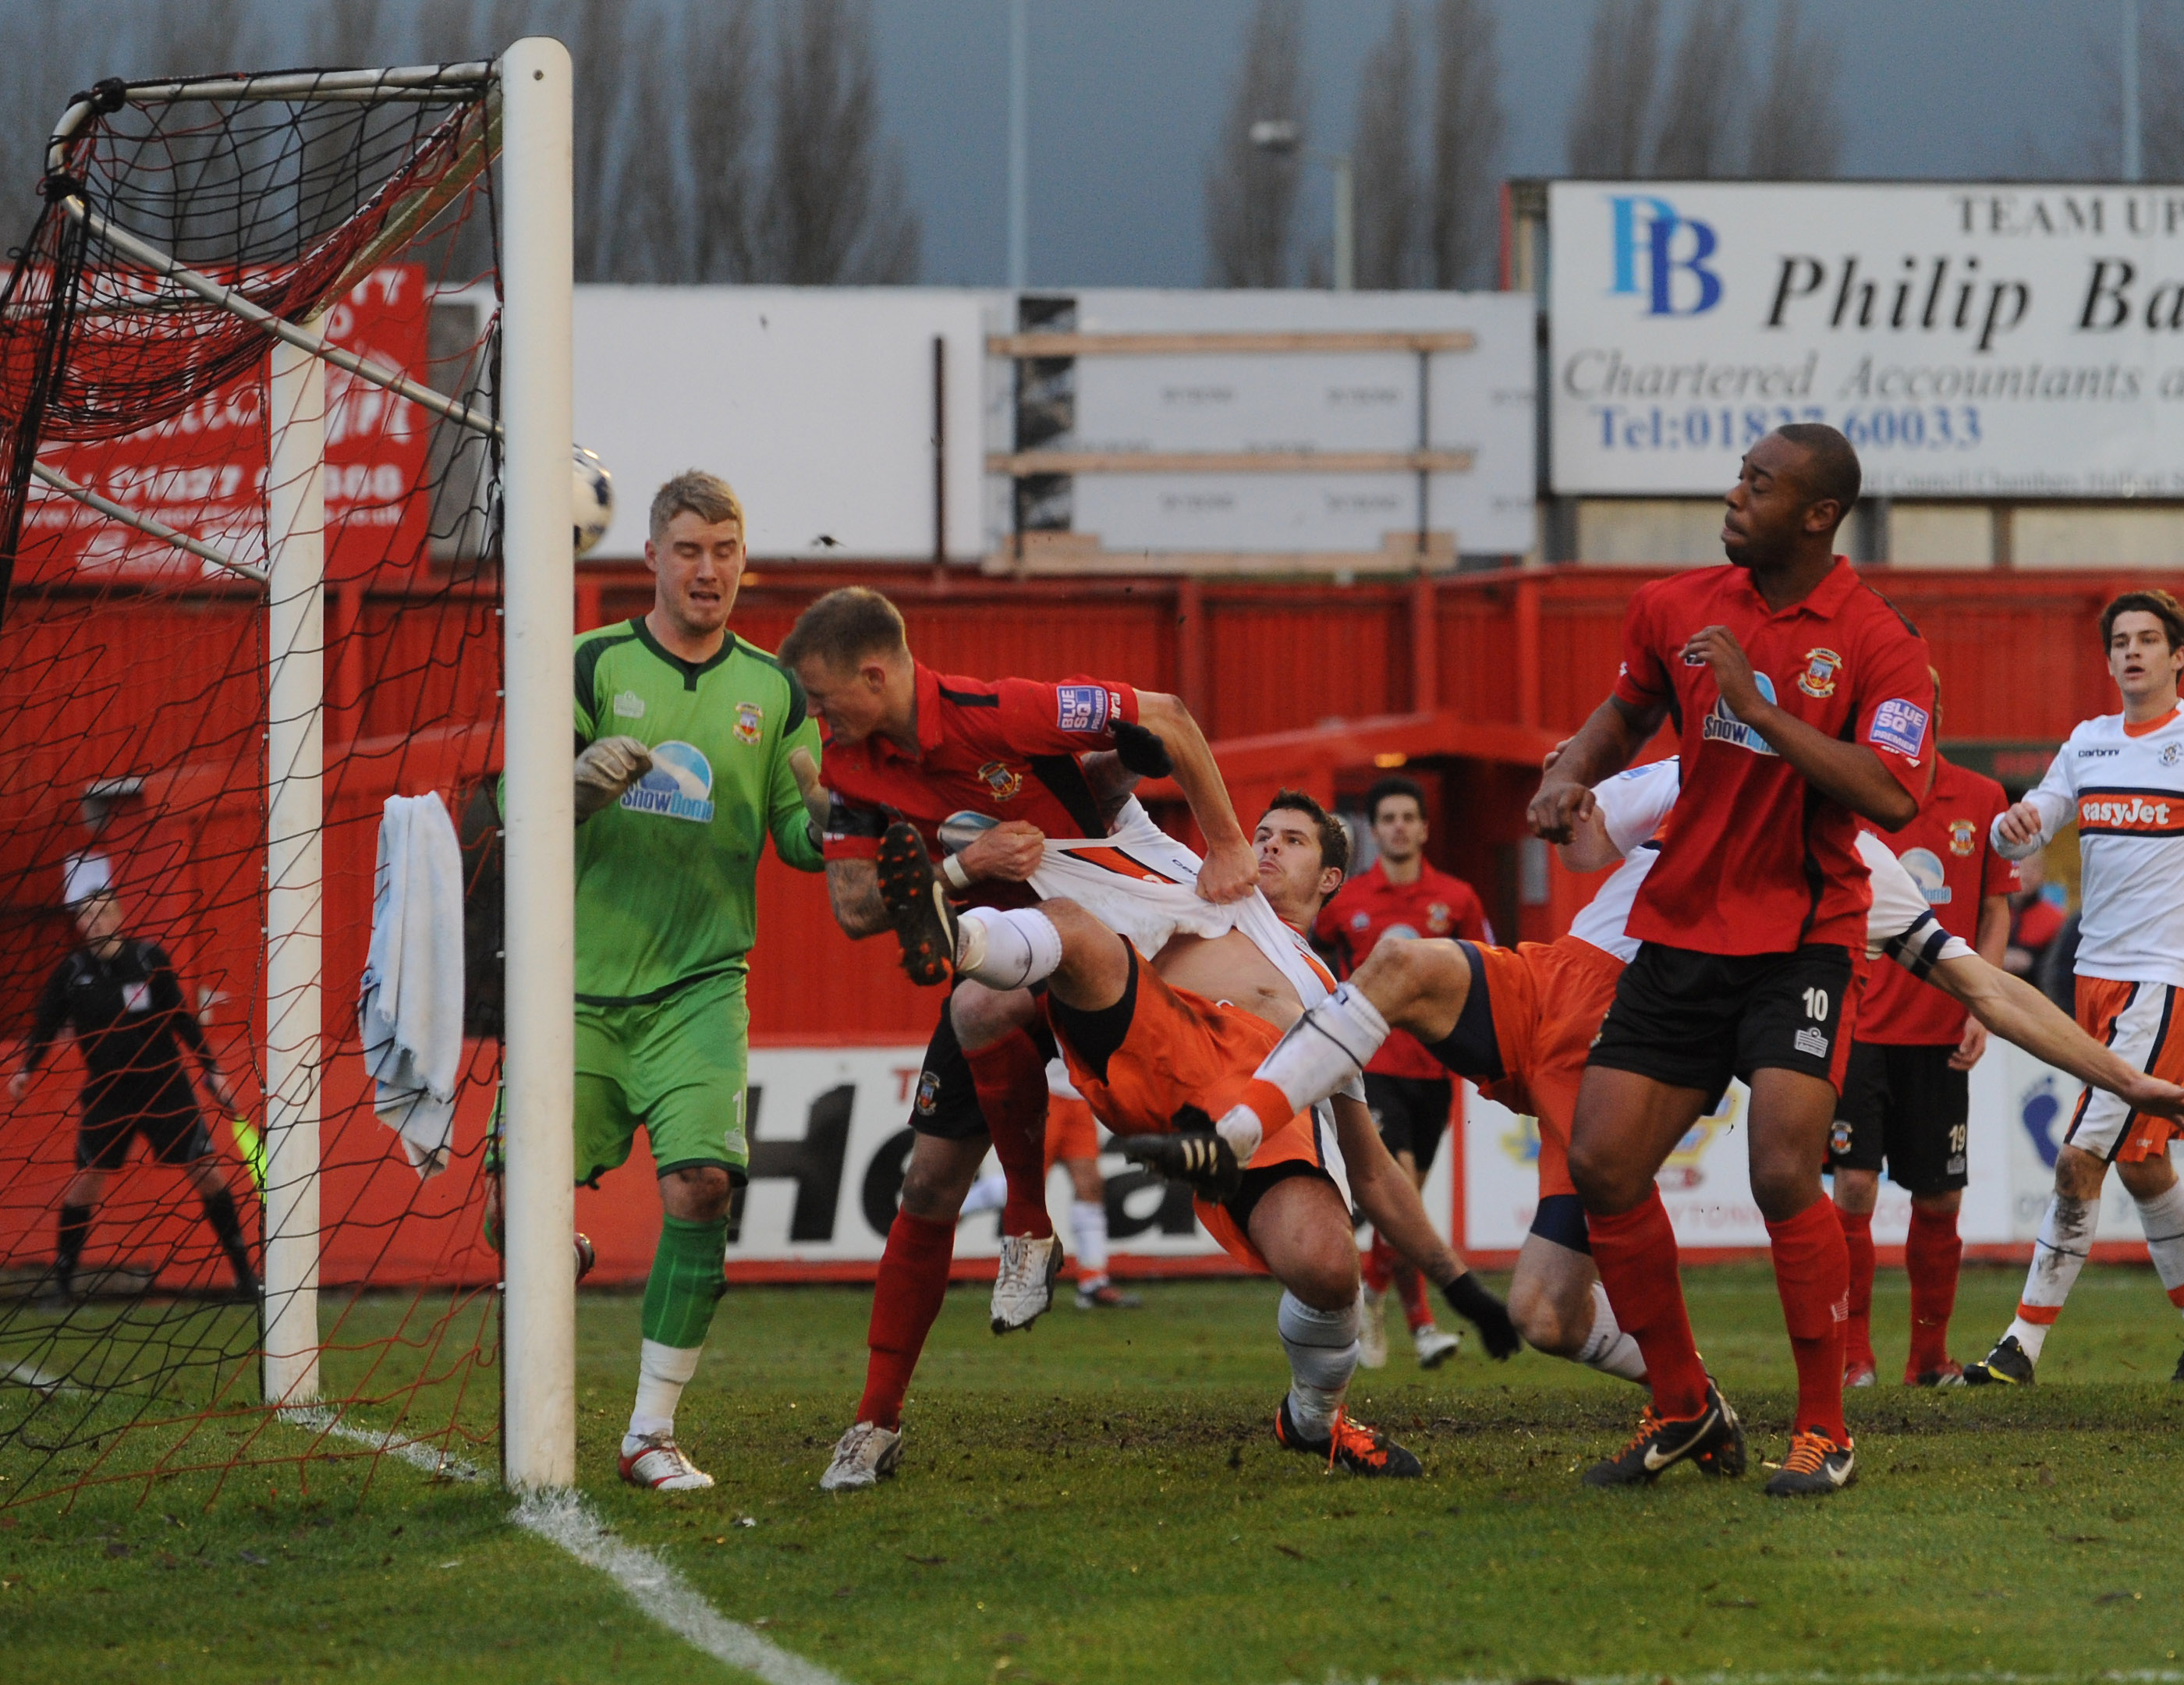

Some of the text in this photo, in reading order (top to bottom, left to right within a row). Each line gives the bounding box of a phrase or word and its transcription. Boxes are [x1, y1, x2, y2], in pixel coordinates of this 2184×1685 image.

[1954, 195, 2108, 236] TEAM
[1764, 254, 2032, 353] Philip
[1563, 349, 1820, 401] Chartered
[1838, 352, 2142, 401] Accountants
[1844, 404, 1982, 449] 60033
[1062, 690, 1076, 729] BLUE
[1073, 703, 1091, 729] SQ
[1090, 690, 1104, 730] PREMIER
[1877, 711, 1908, 733] SQ
[1881, 701, 1924, 727] BLUE
[1873, 729, 1916, 754] PREMIER
[2082, 797, 2170, 827] easyJet
[1802, 986, 1829, 1022] 10
[1948, 1123, 1966, 1153] 19
